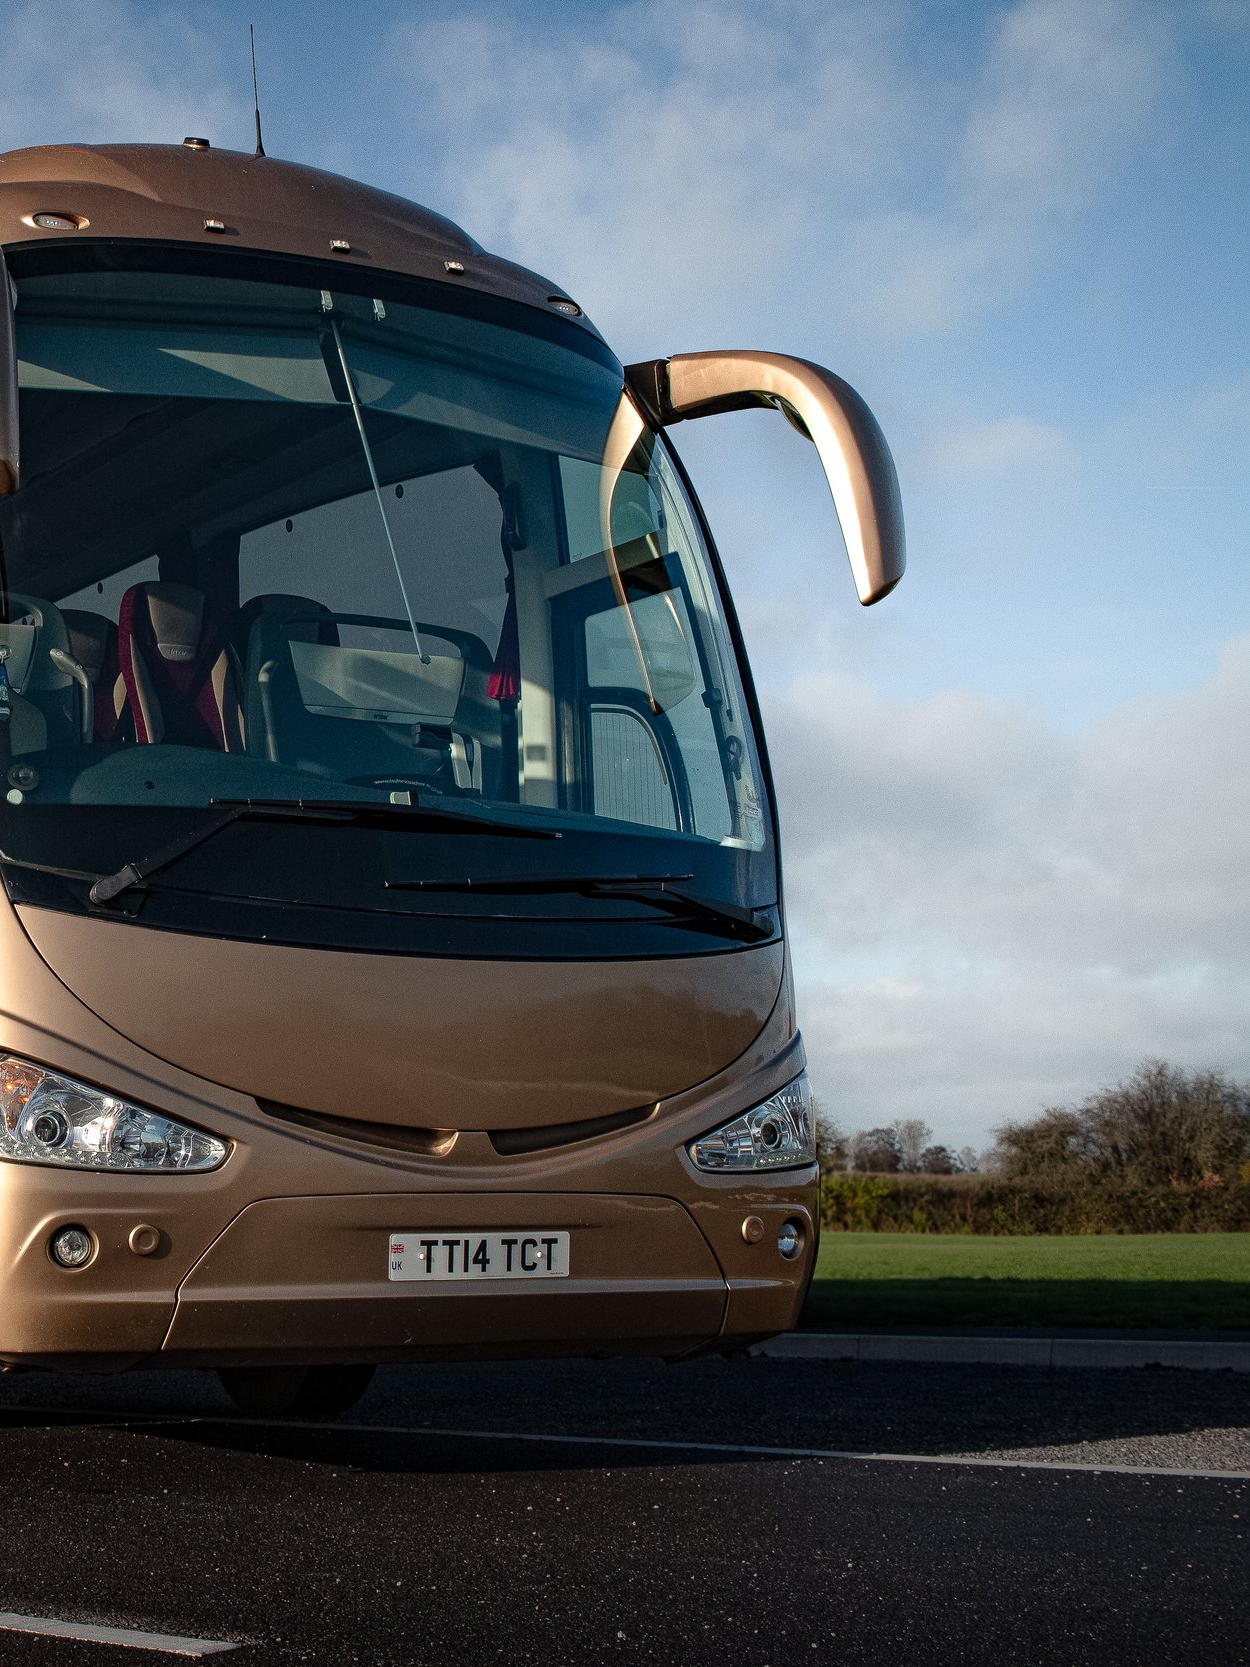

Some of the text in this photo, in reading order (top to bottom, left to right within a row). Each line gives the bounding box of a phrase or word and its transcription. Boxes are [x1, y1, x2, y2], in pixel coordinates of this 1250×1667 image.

[392, 1261, 403, 1271] UK
[420, 1238, 558, 1273] TT14 TCT
